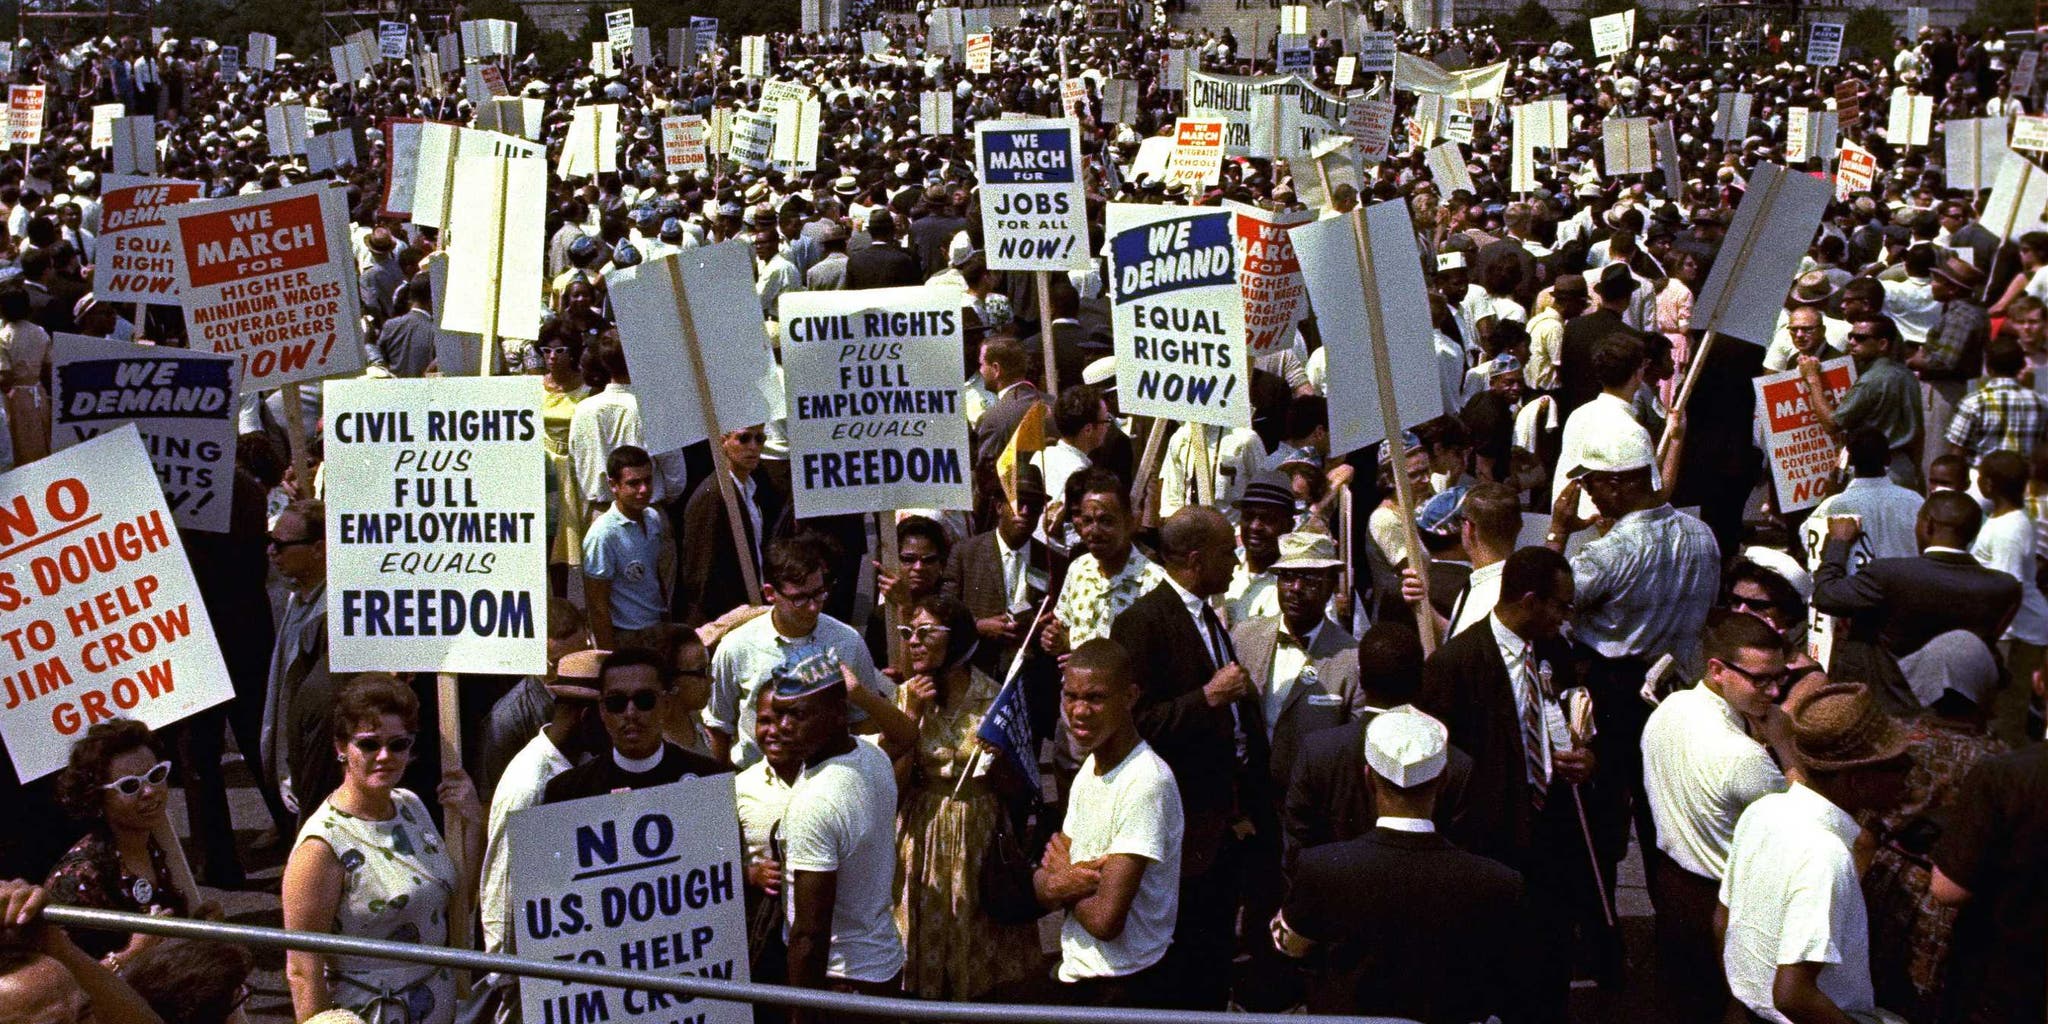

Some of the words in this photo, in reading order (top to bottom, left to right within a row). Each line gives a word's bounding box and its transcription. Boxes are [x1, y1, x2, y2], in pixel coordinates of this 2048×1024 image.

[1011, 134, 1039, 148] WE
[1181, 132, 1219, 140] MARCH
[667, 155, 705, 165] FREEDOM
[732, 146, 765, 161] FREEDOM
[990, 150, 1066, 169] MARCH
[1014, 172, 1044, 180] FOR
[134, 186, 170, 206] WE
[994, 192, 1069, 215] JOBS
[107, 205, 163, 229] DEMA
[230, 209, 273, 233] WE
[998, 220, 1030, 230] FOR
[1039, 220, 1068, 229] ALL
[115, 236, 171, 253] EQUA
[197, 224, 316, 266] MARCH
[998, 234, 1076, 259] NOW!
[1149, 221, 1192, 256] WE
[1259, 225, 1287, 242] WE
[1238, 237, 1295, 261] MARC
[112, 255, 174, 273] RIGHT
[237, 257, 283, 275] FOR
[1122, 245, 1230, 295] DEMAND
[1250, 261, 1283, 273] FOR
[221, 272, 310, 301] HIGHER
[194, 295, 278, 324] MINIMUM
[283, 281, 341, 305] WAGES
[1245, 301, 1276, 315] RAGE
[203, 310, 297, 339] COVERAGE
[305, 301, 339, 318] FOR
[789, 315, 854, 342] CIVIL
[864, 311, 955, 337] RIGHTS
[1134, 305, 1226, 336] EQUAL
[213, 337, 244, 354] ALL
[250, 317, 335, 346] WORKERS
[1245, 321, 1289, 350] OW!
[839, 343, 903, 362] PLUS
[1134, 336, 1231, 369] RIGHTS
[114, 361, 180, 388] WE
[840, 364, 909, 389] FULL
[69, 386, 226, 416] DEMAND
[1137, 370, 1236, 408] NOW!
[797, 390, 958, 420] EMPLOYMENT
[335, 411, 414, 443] CIVIL
[428, 409, 535, 442] RIGHTS
[832, 420, 927, 440] EQUALS
[73, 425, 222, 462] VING
[1775, 439, 1827, 458] MINIMUM
[394, 450, 473, 472] PLUS
[803, 448, 962, 490] FREEDOM
[1781, 450, 1836, 470] COVERAG
[1788, 468, 1809, 480] ALL
[395, 478, 478, 508] FULL
[1792, 477, 1825, 503] NO
[0, 477, 90, 547] NO
[340, 512, 535, 544] EMPLOYMENT
[29, 510, 170, 597] DOUGH
[380, 552, 496, 575] EQUALS
[1, 620, 56, 661] TO
[64, 575, 159, 638] HELP
[342, 589, 535, 639] FREEDOM
[4, 656, 74, 710] JIM
[81, 603, 191, 674] CROW
[51, 658, 175, 736] GROW
[577, 813, 674, 868] NO
[526, 893, 593, 939] U.S.
[601, 861, 734, 928] DOUGH
[621, 926, 714, 970] HELP
[543, 990, 609, 1024] JIM
